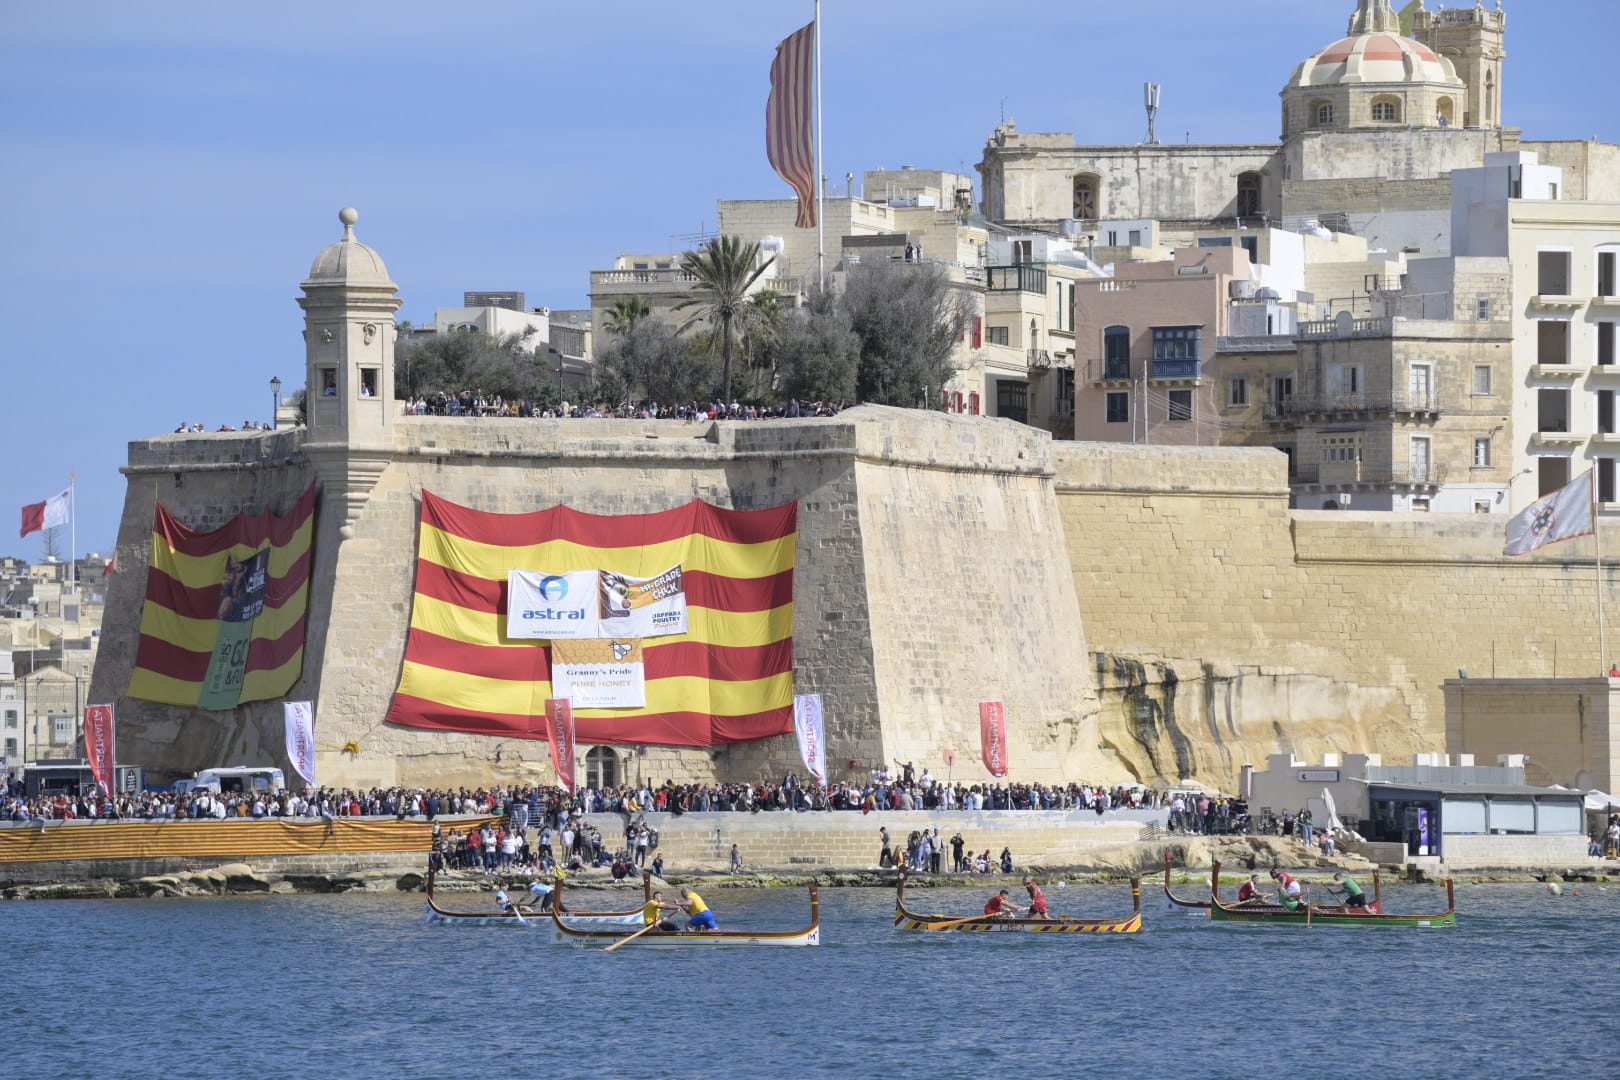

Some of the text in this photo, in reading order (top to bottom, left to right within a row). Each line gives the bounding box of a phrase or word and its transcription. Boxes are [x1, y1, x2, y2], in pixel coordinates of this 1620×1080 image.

[652, 582, 678, 600] CHICK
[522, 608, 585, 620] astral
[653, 616, 681, 624] POULTRY
[566, 668, 633, 677] Granny's Pride
[599, 680, 631, 688] HONEY
